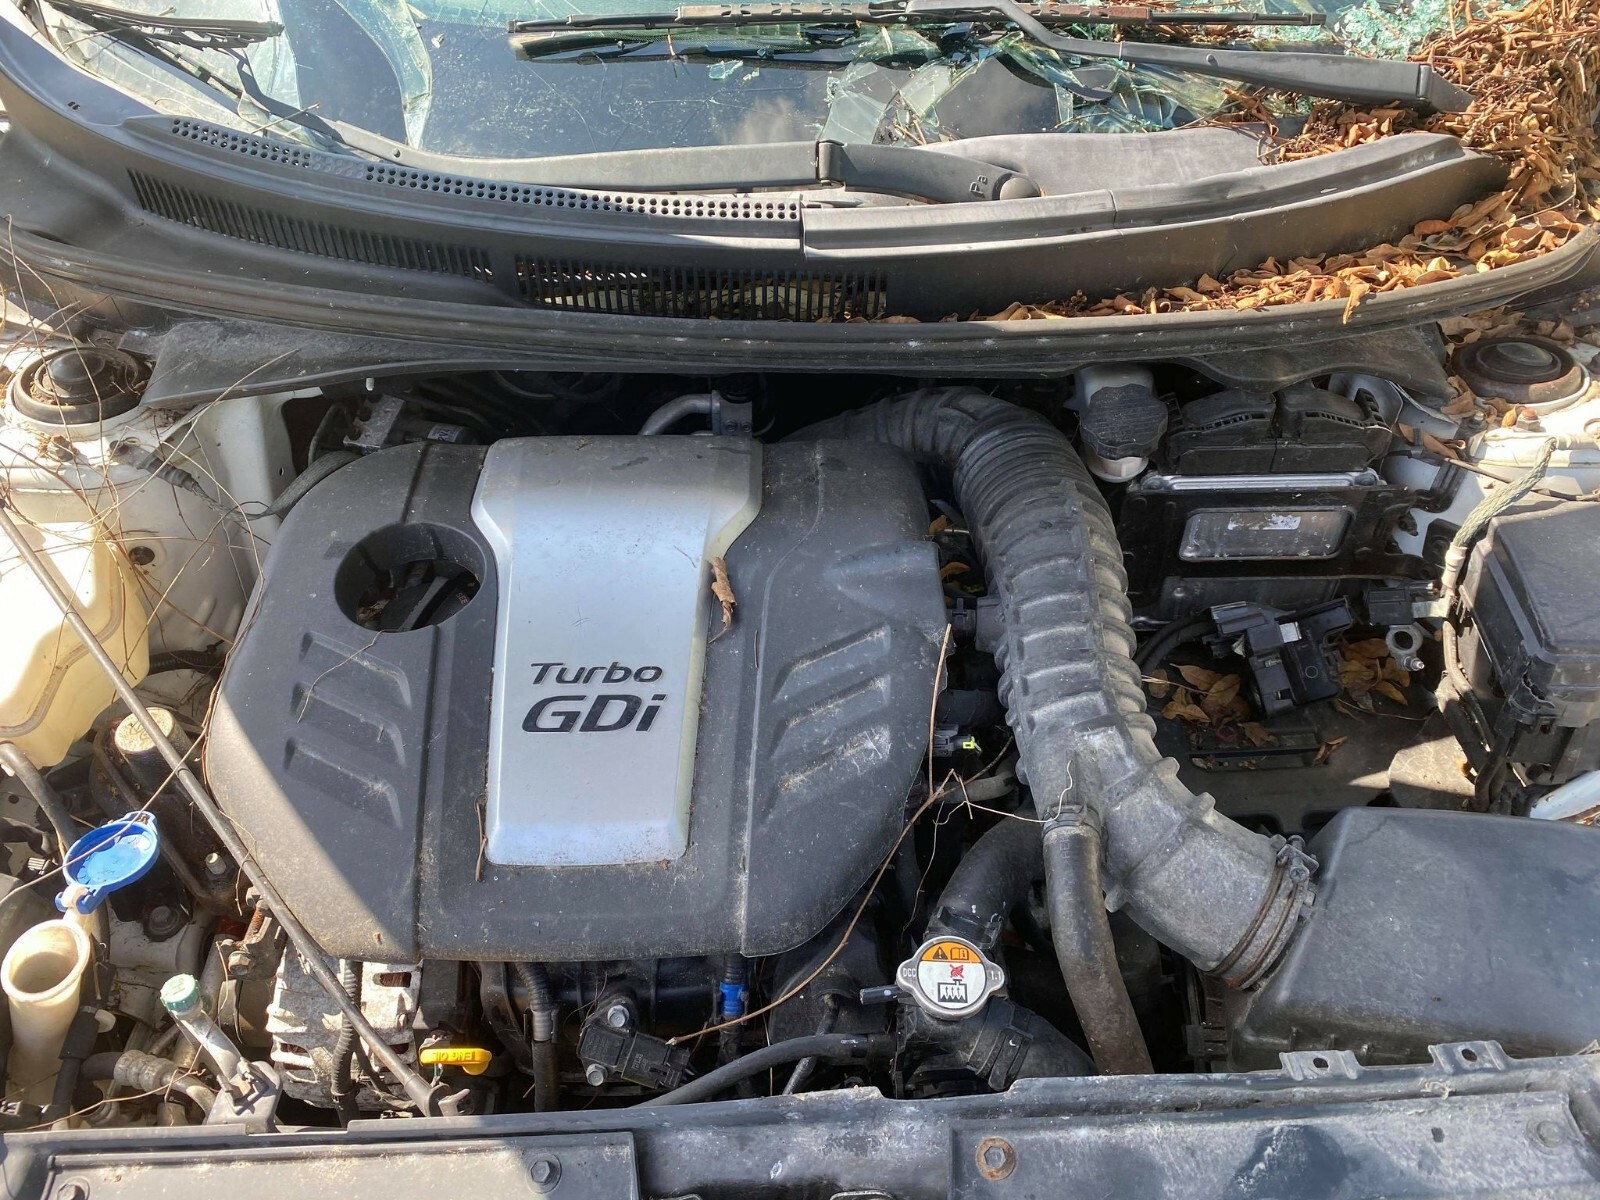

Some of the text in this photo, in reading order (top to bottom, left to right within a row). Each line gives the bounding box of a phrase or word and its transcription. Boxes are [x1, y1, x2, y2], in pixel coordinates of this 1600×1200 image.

[531, 661, 663, 685] Turbo
[522, 694, 667, 733] GDi
[990, 970, 1001, 981] 1.1
[432, 1051, 476, 1062] ENG OIL
